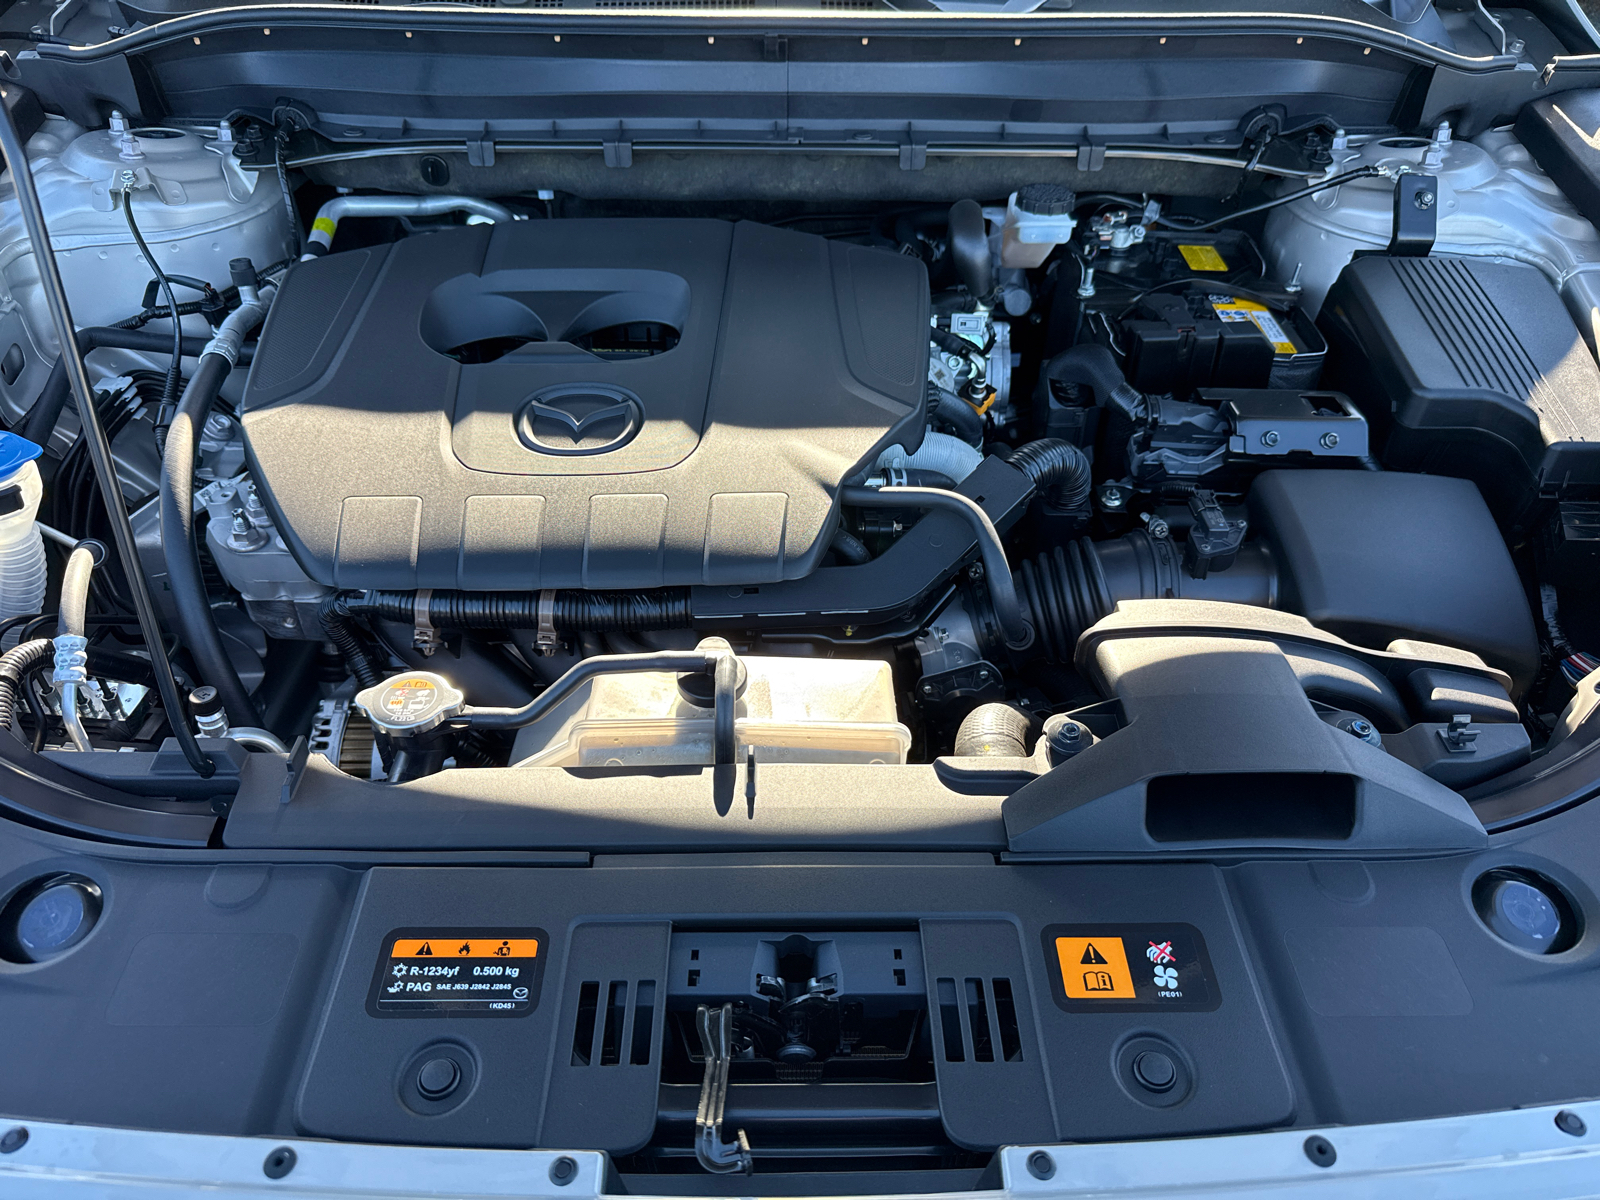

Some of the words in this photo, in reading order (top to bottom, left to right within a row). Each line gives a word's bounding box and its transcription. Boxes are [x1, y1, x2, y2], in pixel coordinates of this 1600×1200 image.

[410, 966, 460, 977] R-1234yf
[473, 966, 503, 976] 0.500
[505, 966, 520, 978] kg
[406, 982, 432, 992] PAG
